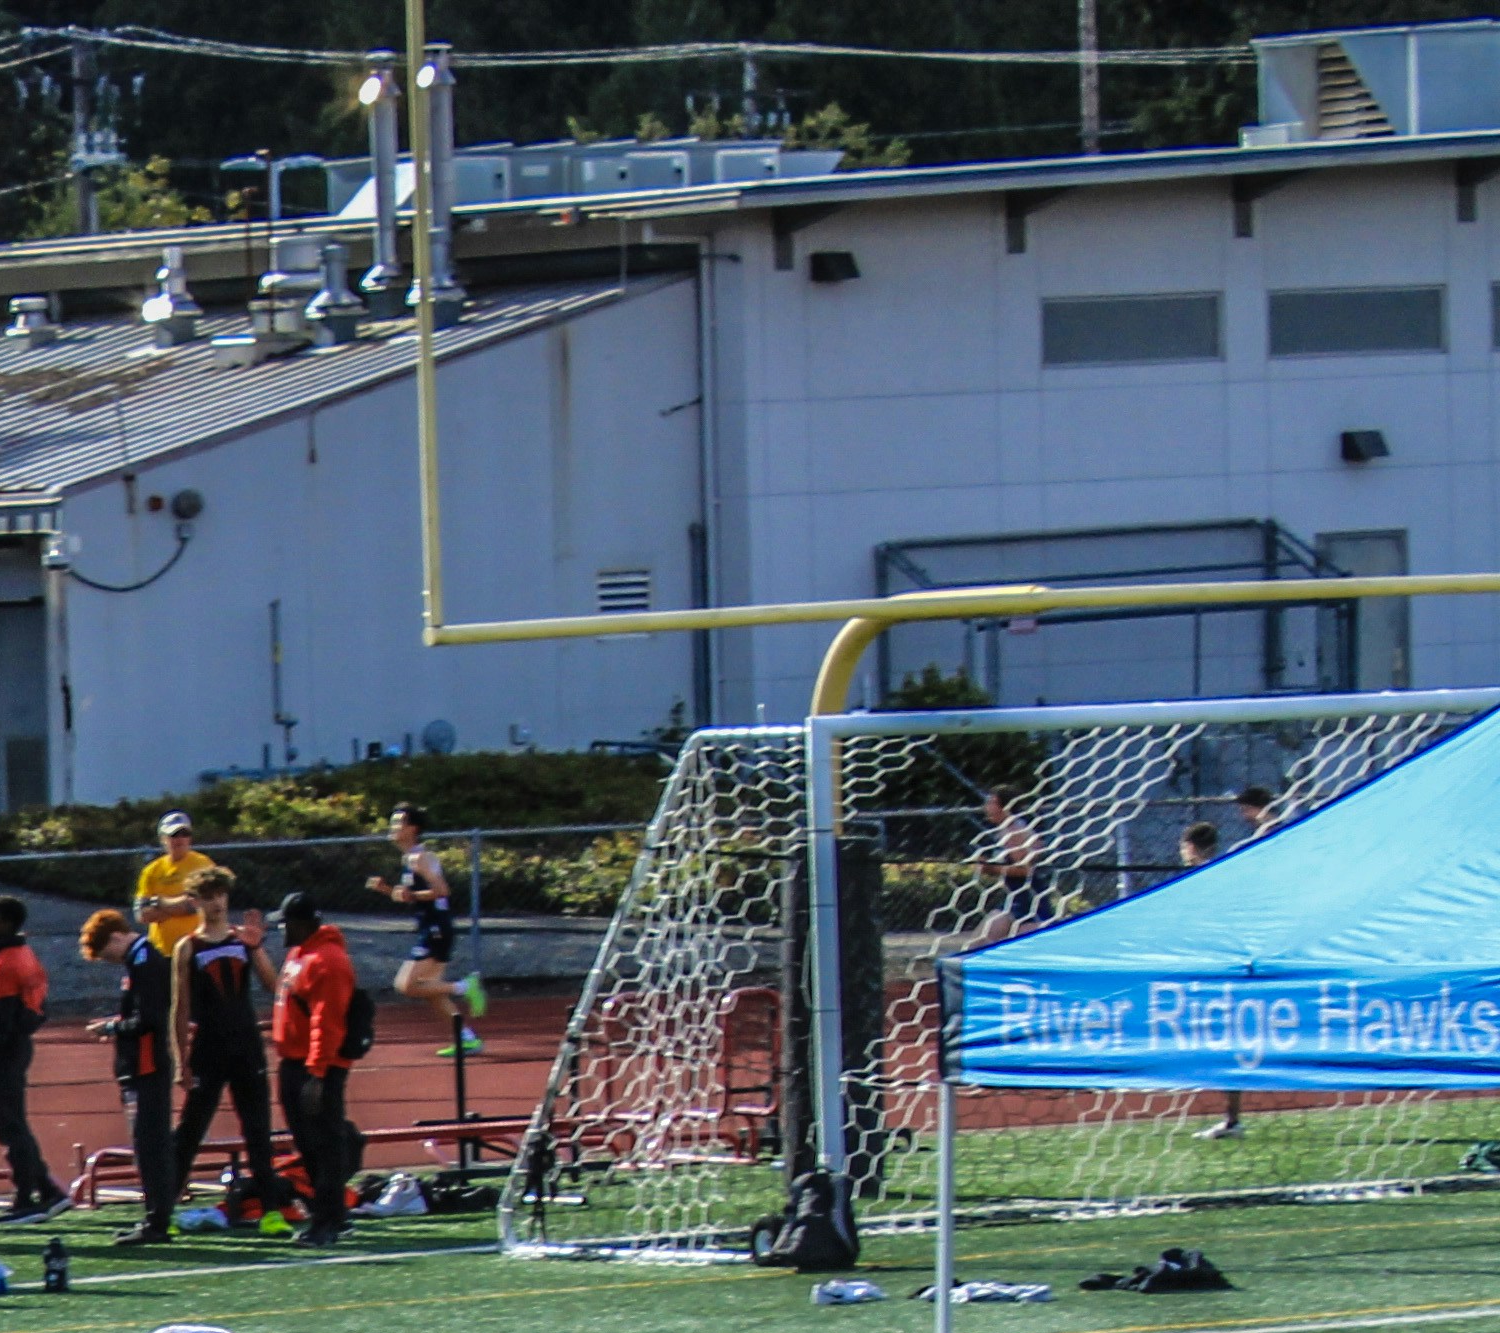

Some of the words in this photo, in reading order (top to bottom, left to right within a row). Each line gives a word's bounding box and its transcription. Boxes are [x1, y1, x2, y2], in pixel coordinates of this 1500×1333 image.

[1000, 983, 1133, 1051] River
[1148, 981, 1300, 1069] Ridge
[1318, 980, 1500, 1053] Hawks
